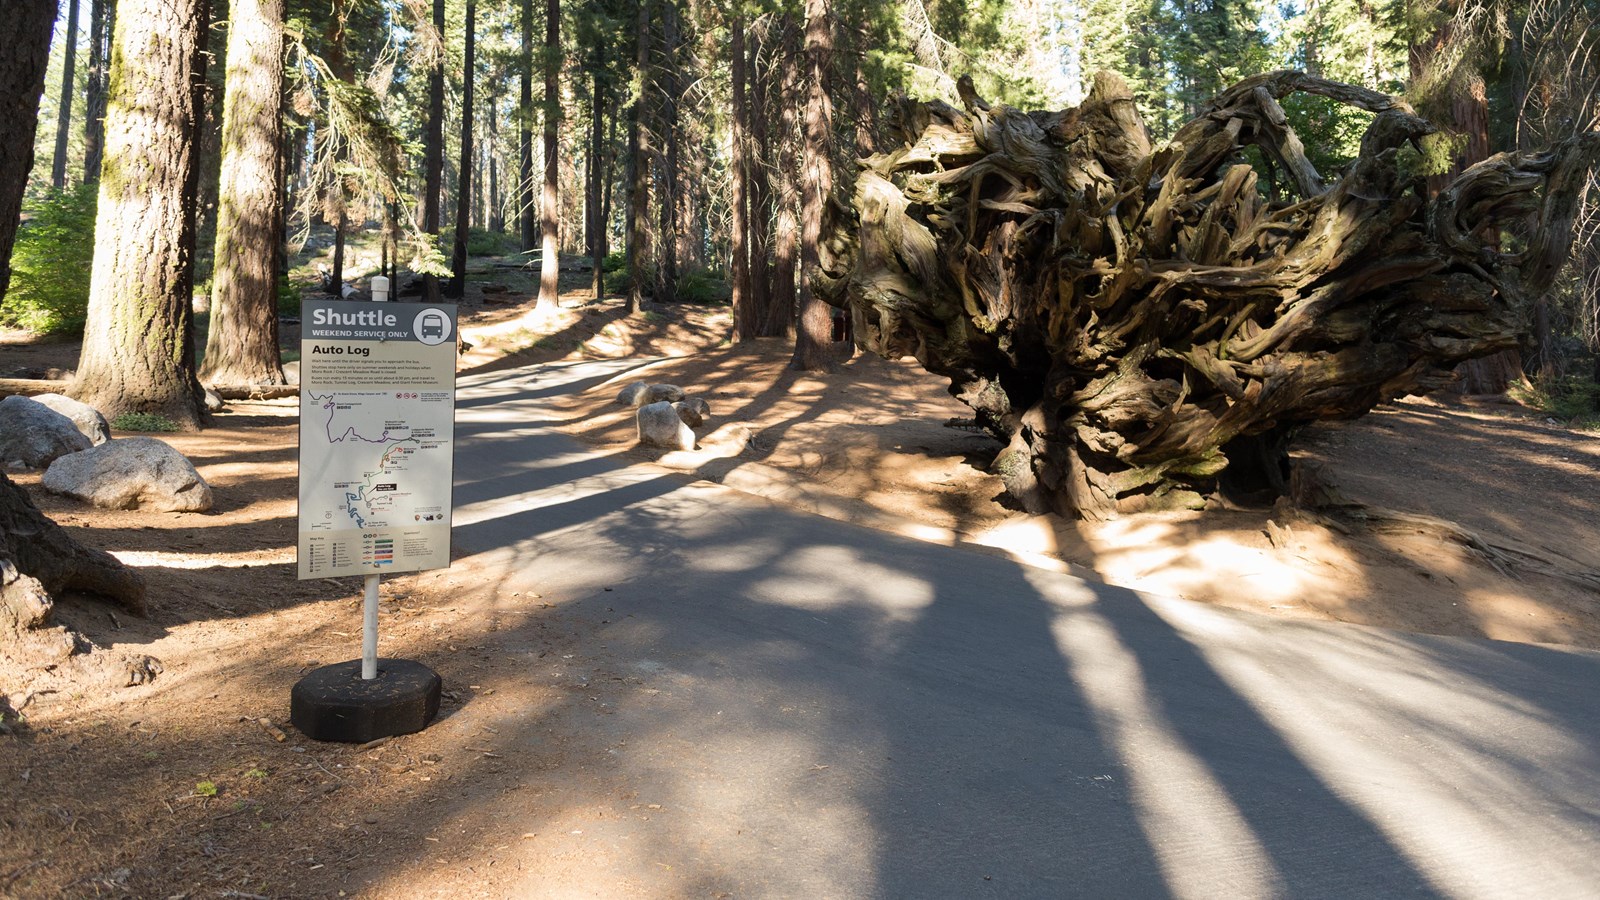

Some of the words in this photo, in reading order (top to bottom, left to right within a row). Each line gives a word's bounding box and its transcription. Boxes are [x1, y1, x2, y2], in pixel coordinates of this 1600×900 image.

[312, 308, 397, 326] Shuttle
[312, 329, 352, 337] WEEKEND
[312, 345, 344, 354] Auto
[348, 346, 370, 357] Log
